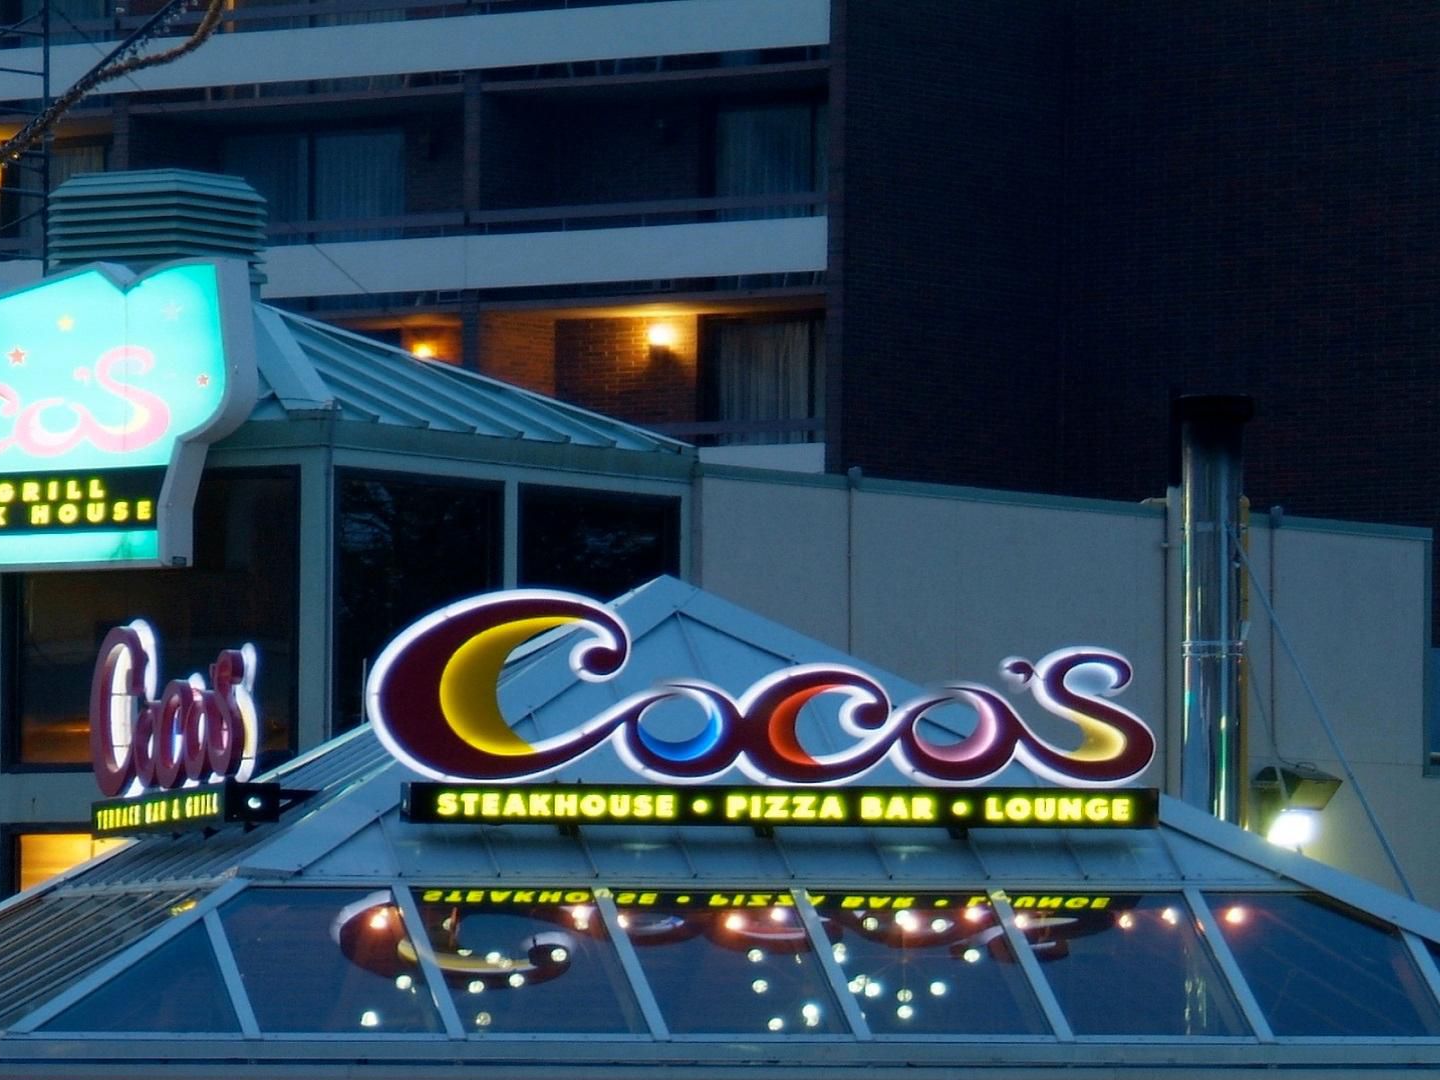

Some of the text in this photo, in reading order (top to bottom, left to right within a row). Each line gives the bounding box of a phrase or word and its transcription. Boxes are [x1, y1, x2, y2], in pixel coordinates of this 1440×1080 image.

[30, 500, 153, 524] HOUSE
[145, 800, 166, 824] BAR
[185, 792, 218, 818] GRILL
[436, 792, 1131, 822] STEAKHOUSE PIZZA BAR LOUNGE
